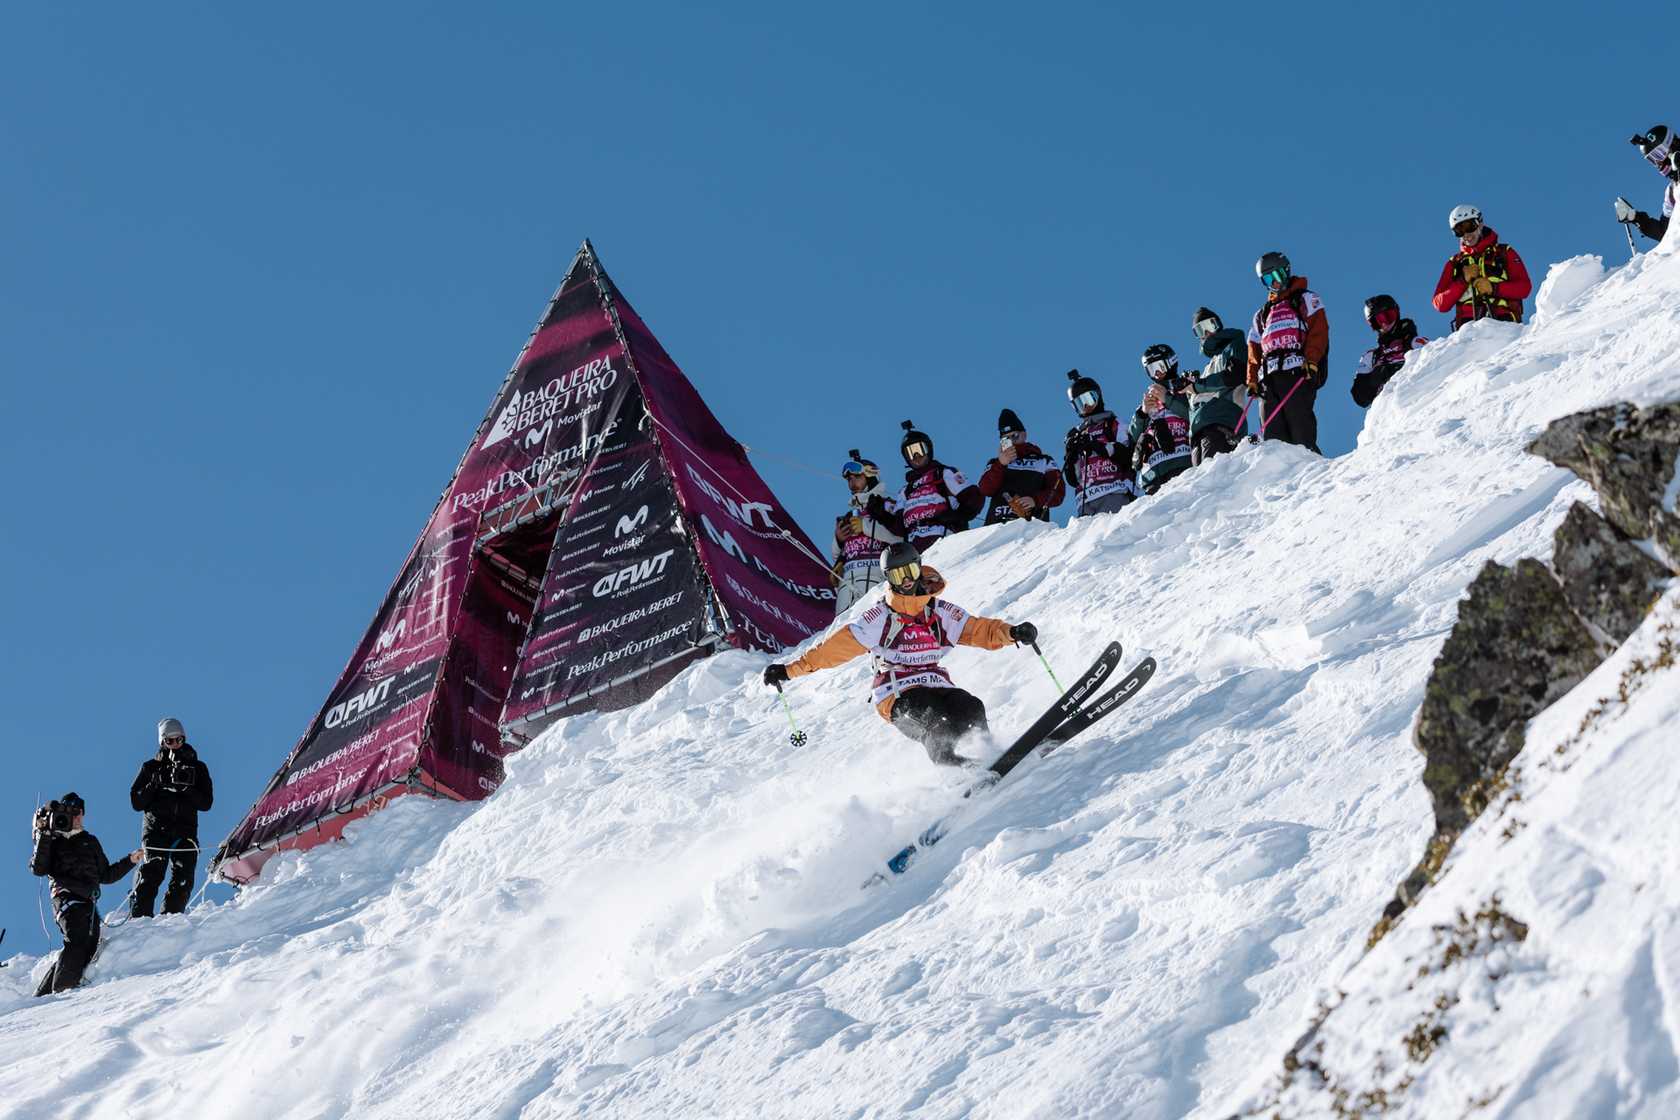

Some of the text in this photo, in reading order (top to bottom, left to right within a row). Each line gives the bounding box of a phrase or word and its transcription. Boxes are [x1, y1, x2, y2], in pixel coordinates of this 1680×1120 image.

[517, 370, 618, 432] BERET PRO
[521, 354, 611, 412] BAQUEIRA
[557, 401, 602, 428] Movistar
[602, 534, 646, 558] Movistar
[613, 549, 674, 591] FWT
[753, 554, 837, 600] Movista
[567, 621, 691, 680] PeakPerformance
[343, 676, 396, 721] FWT
[1061, 663, 1107, 711] HEAD
[1086, 678, 1139, 719] HEAD
